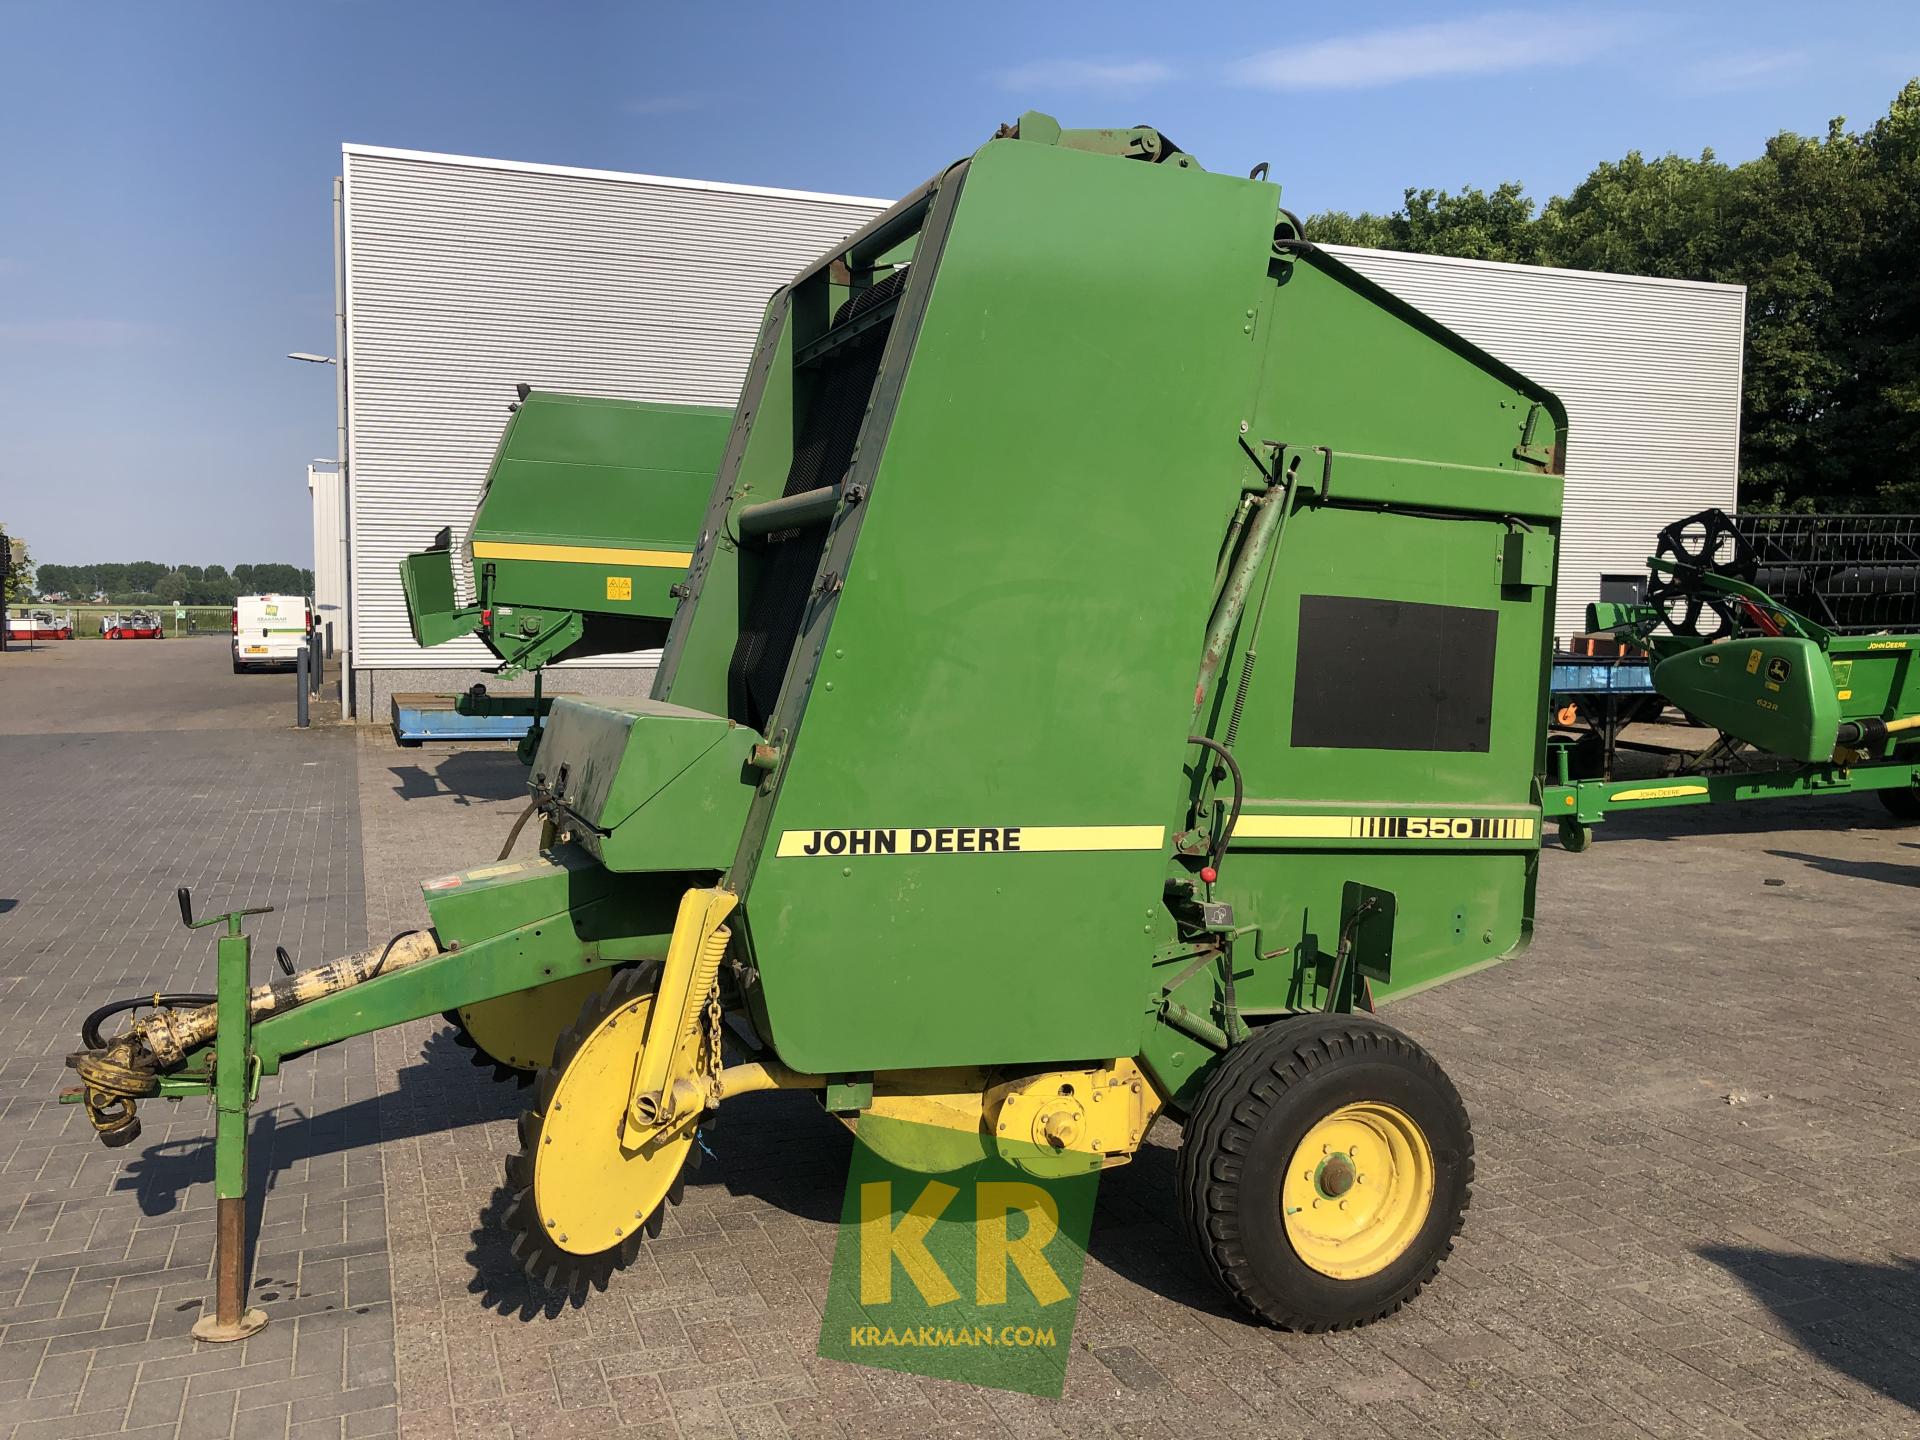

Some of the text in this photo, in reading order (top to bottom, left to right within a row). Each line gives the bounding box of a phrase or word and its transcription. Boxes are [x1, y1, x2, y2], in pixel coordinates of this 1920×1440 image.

[1867, 640, 1907, 650] JOHN DEERE
[1639, 788, 1681, 798] JOHN DEERE
[1406, 817, 1473, 839] 550
[803, 827, 1021, 855] JOHN DEERE
